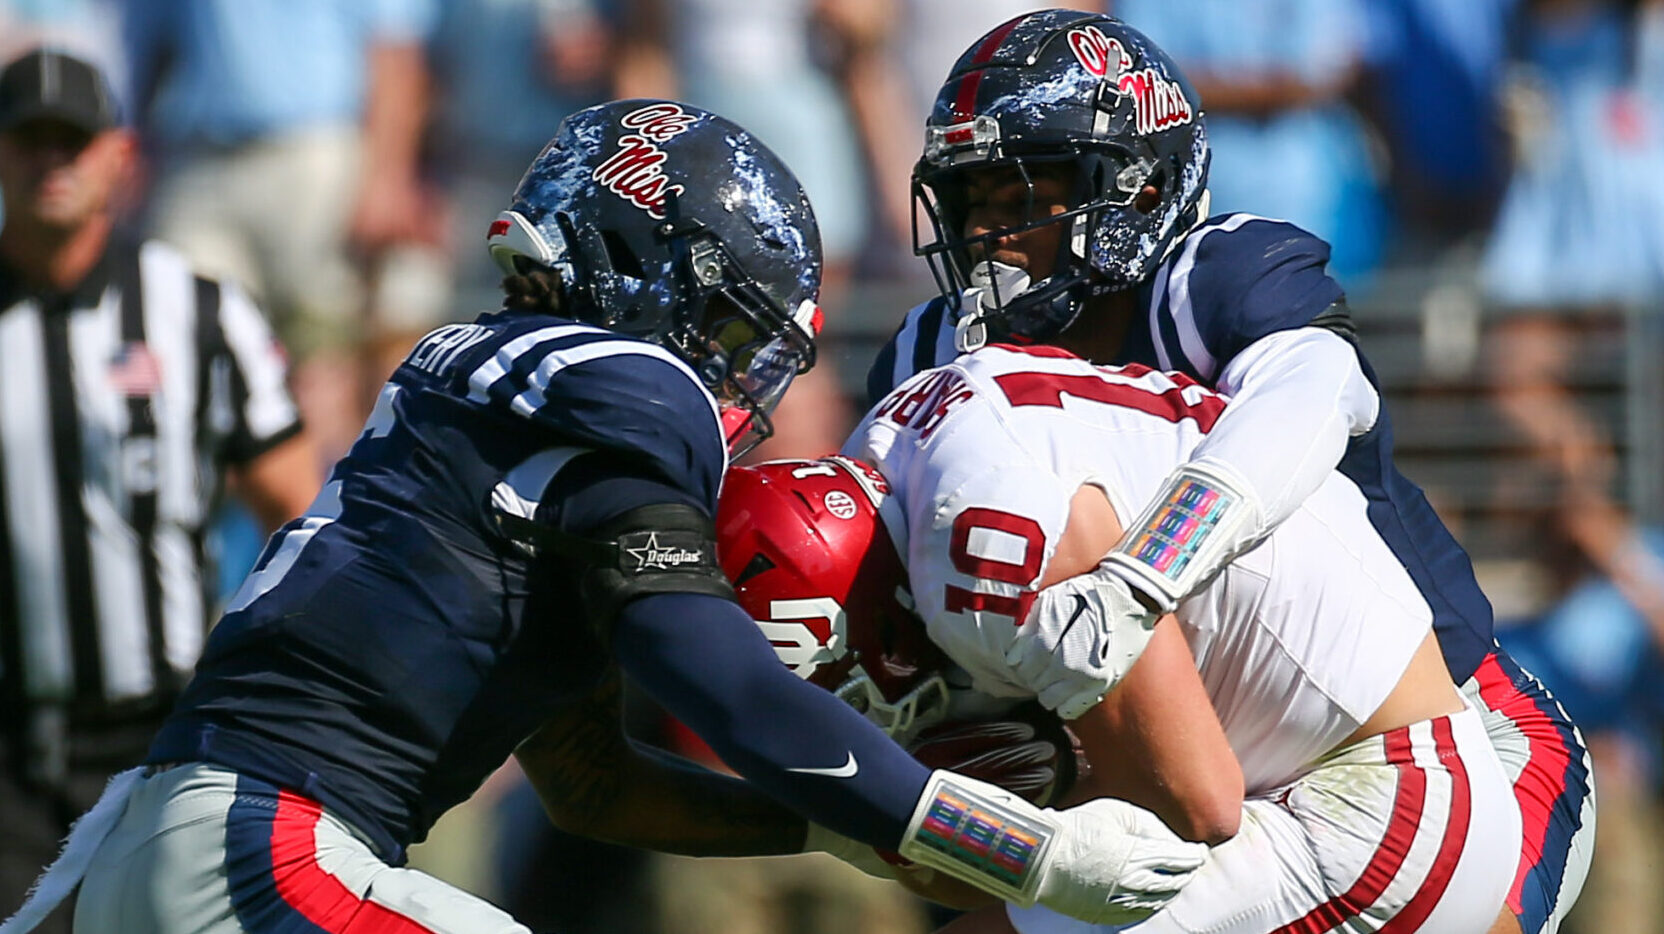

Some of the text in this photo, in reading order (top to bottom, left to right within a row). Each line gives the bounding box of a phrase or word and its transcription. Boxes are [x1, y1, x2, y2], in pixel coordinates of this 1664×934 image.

[1117, 68, 1193, 136] Miss
[621, 103, 697, 142] Ole
[827, 493, 854, 516] SEC
[647, 549, 701, 566] Douglas
[945, 507, 1046, 627] 10
